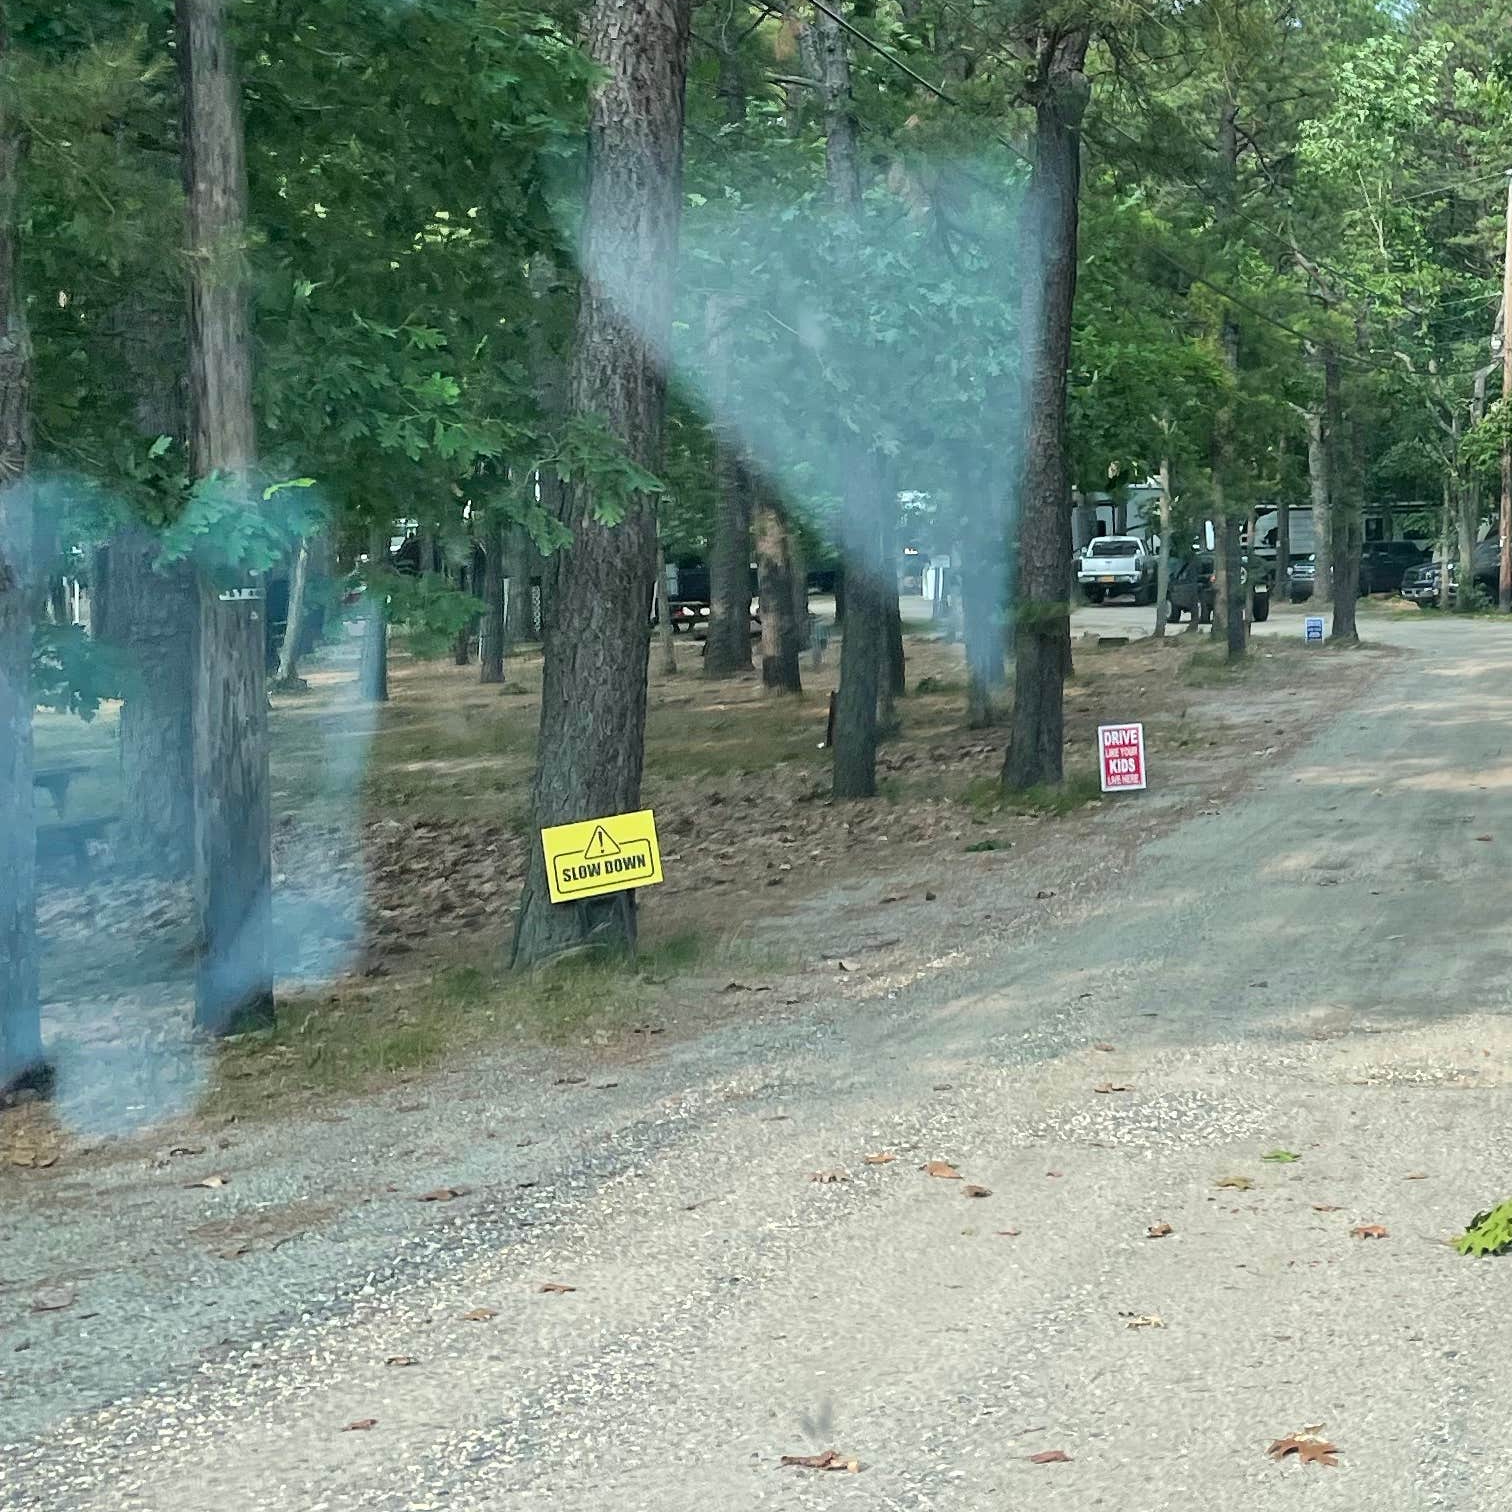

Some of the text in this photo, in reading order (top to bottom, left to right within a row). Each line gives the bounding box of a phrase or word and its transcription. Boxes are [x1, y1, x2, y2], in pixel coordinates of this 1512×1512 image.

[1104, 729, 1138, 746] DRIVE
[1109, 757, 1136, 774] KIDS
[562, 853, 647, 883] SLOW DOWN
